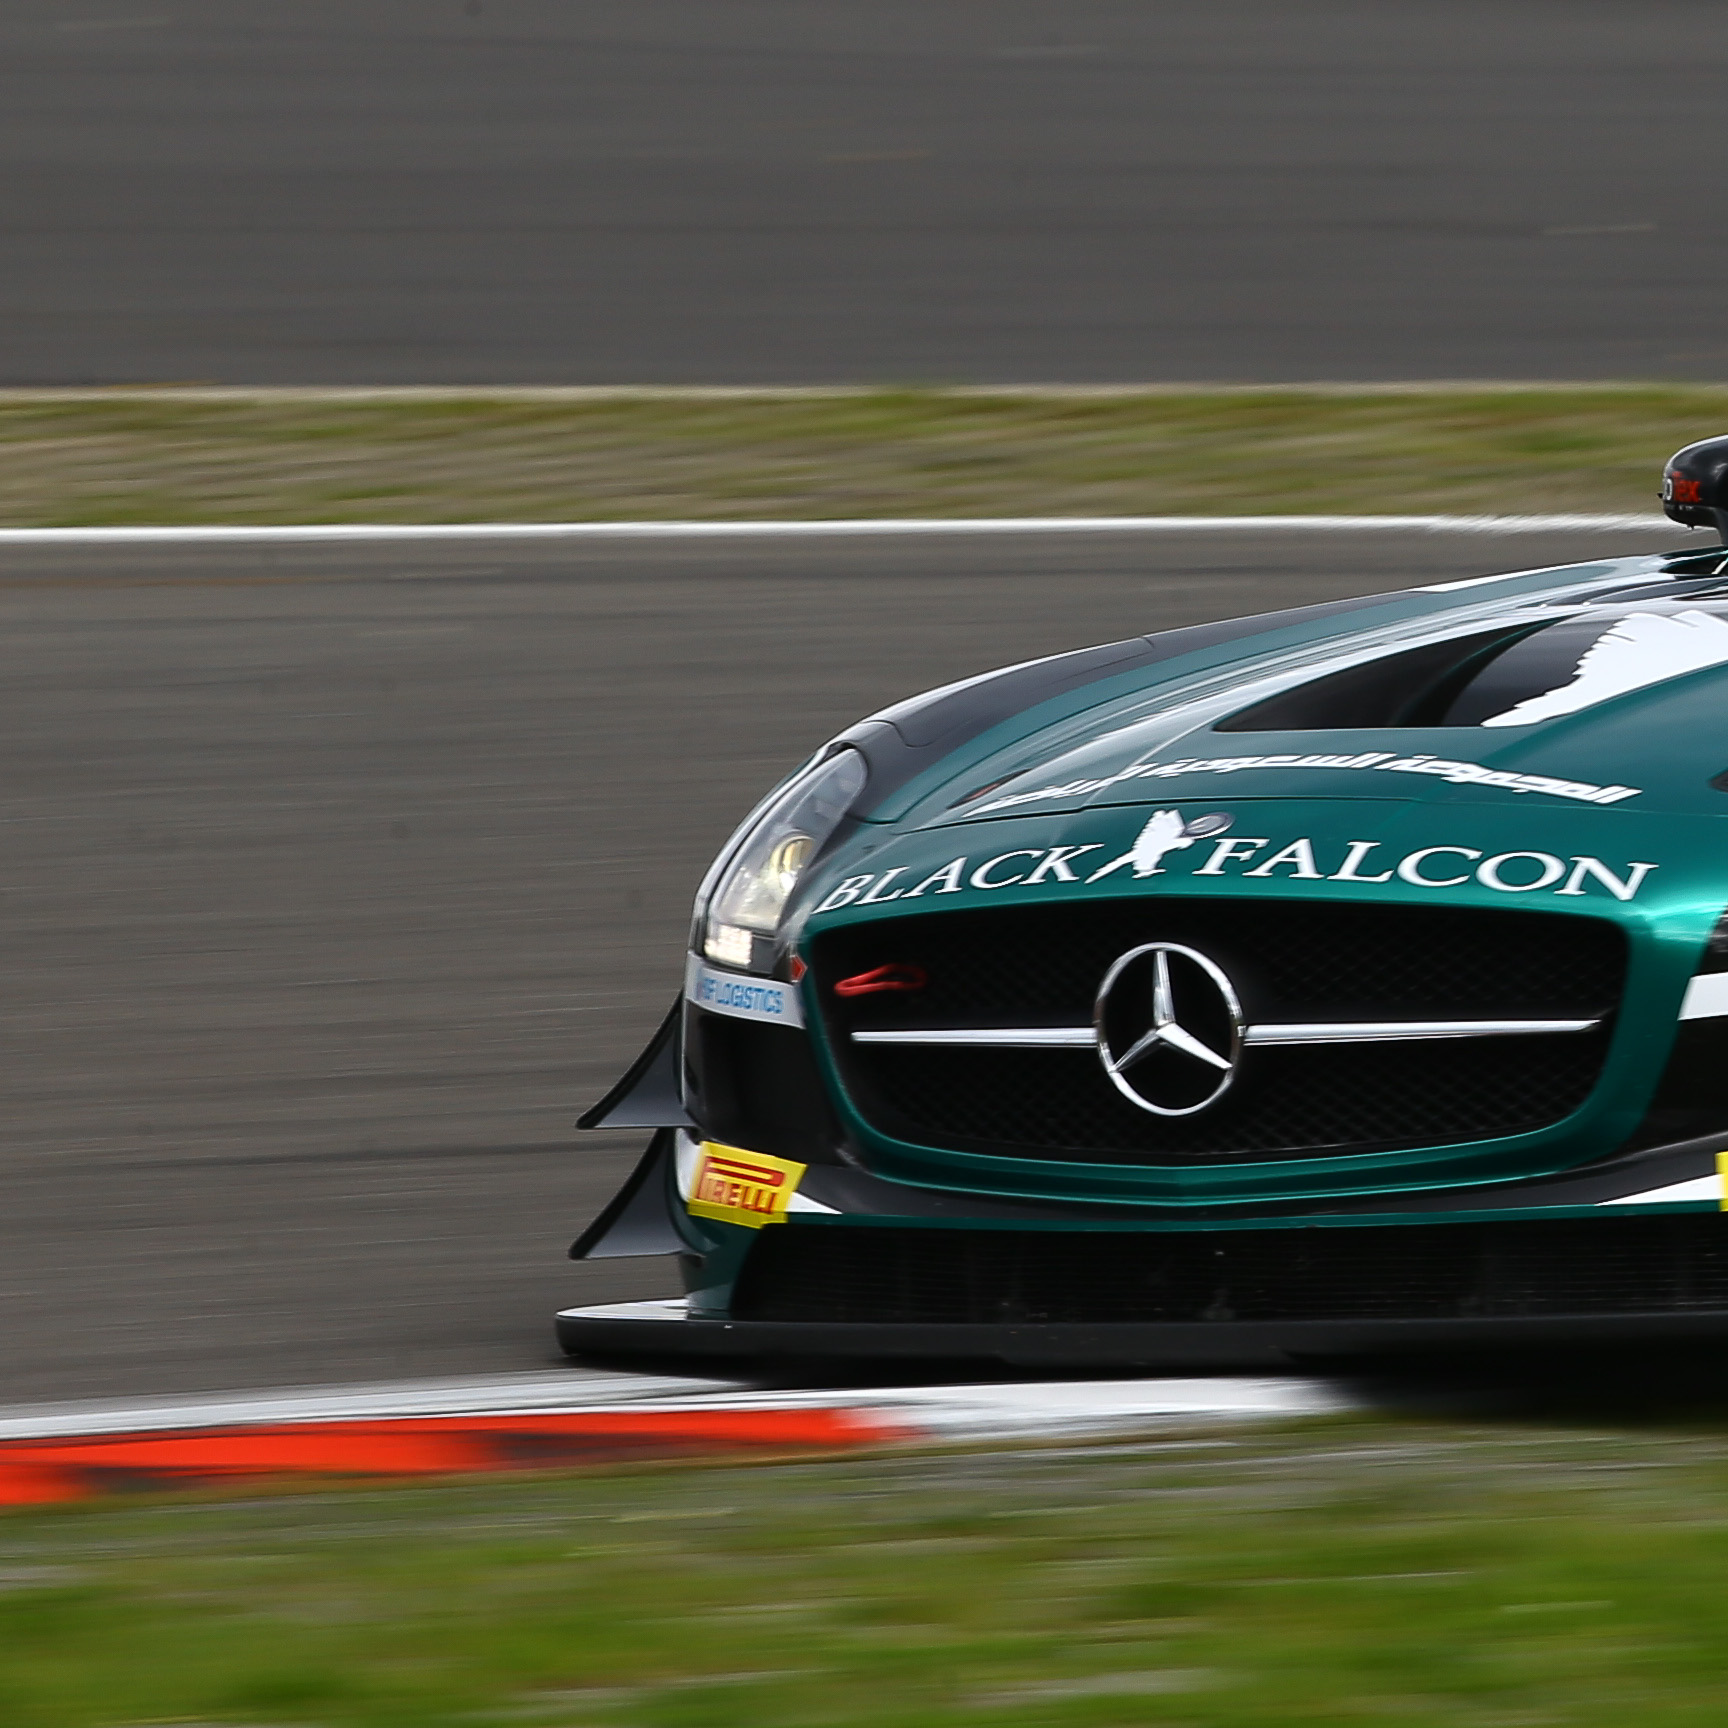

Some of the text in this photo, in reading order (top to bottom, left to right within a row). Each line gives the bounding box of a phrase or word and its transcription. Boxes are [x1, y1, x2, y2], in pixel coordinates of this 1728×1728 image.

[811, 836, 1661, 915] BLACK FALCON
[695, 1155, 786, 1215] PIRELLI
